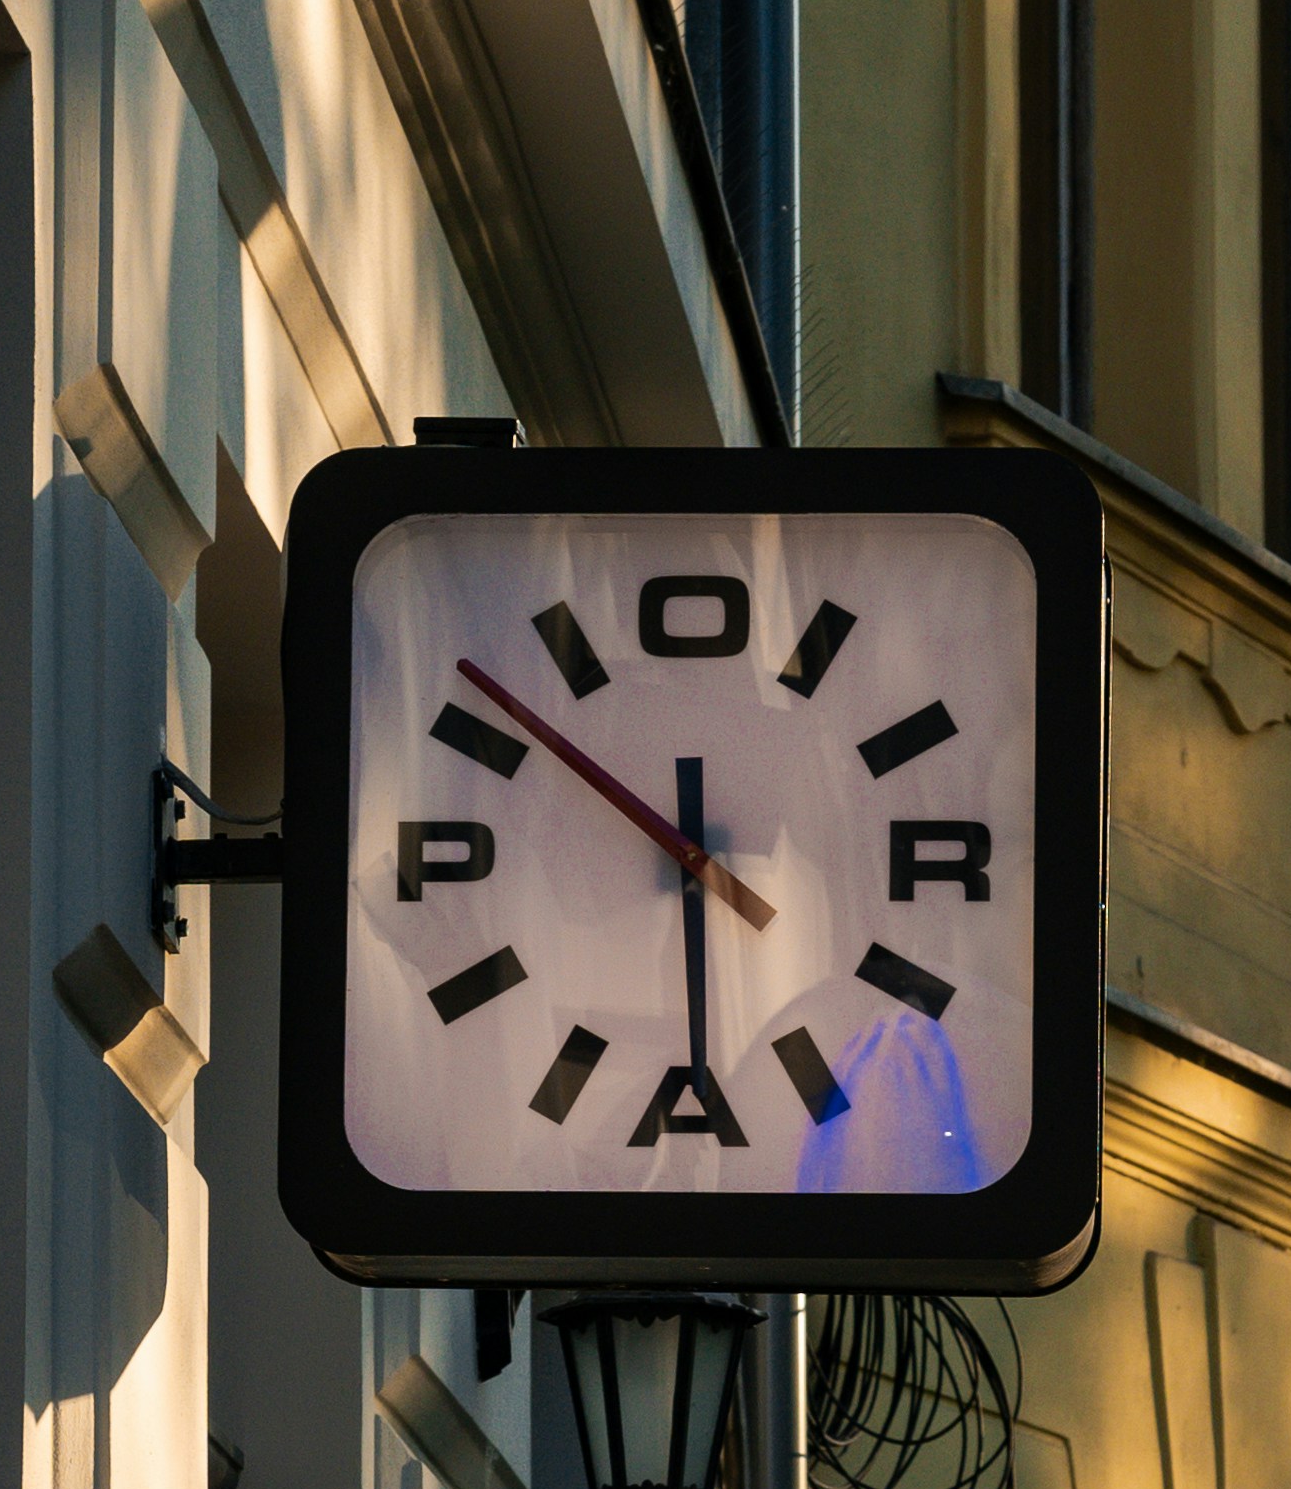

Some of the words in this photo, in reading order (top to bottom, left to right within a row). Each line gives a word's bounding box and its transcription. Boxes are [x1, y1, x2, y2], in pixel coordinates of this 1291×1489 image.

[638, 575, 750, 658] O
[396, 820, 496, 902] P
[888, 819, 992, 902] R
[626, 1065, 750, 1148] A
